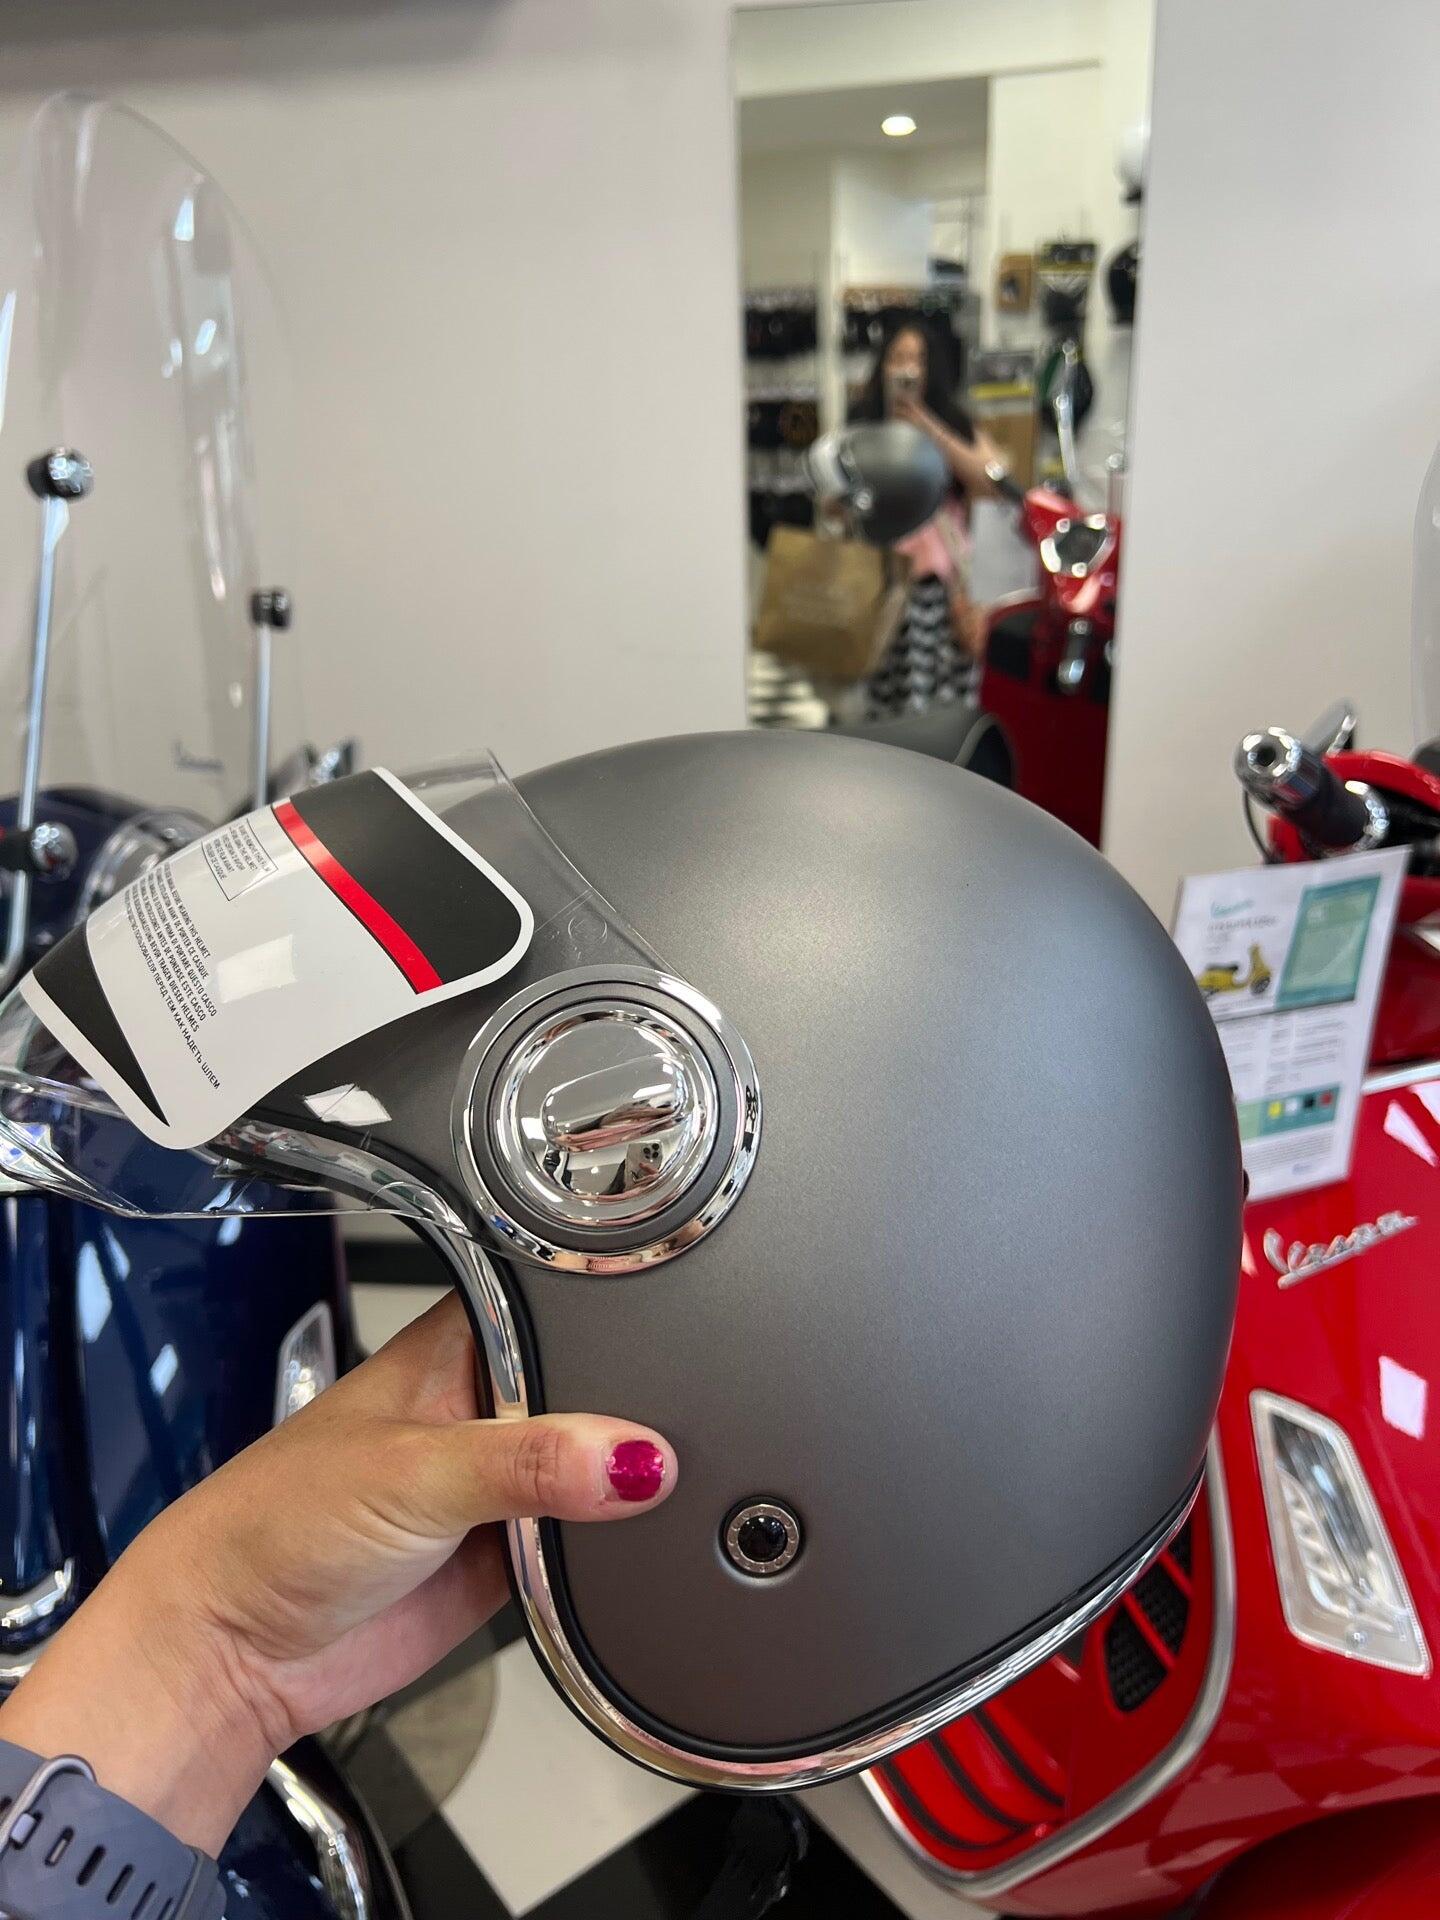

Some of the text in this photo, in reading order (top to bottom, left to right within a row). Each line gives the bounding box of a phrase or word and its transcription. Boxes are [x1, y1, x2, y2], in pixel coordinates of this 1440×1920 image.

[163, 922, 175, 939] PRIMA
[173, 920, 182, 928] DE
[177, 903, 192, 925] WEARING
[187, 924, 198, 937] THIS
[194, 936, 210, 959] HELMET
[156, 930, 167, 947] ANTES
[170, 937, 178, 945] DI
[177, 926, 192, 948] PORTER
[163, 946, 172, 955] DE
[173, 944, 191, 970] PORTARE
[187, 946, 196, 955] CE
[167, 954, 185, 982] PONERSE
[191, 954, 209, 979] CASQUE
[149, 940, 162, 959] BEVOR
[157, 958, 173, 981] TRAGEN
[168, 980, 184, 1004] DIESER
[179, 1002, 200, 1033] HELMES
[180, 980, 194, 998] ESTE
[186, 968, 205, 994] QUESTO
[189, 997, 206, 1021] CASCO
[199, 992, 218, 1017] CASCO
[153, 972, 169, 997] ПЕРЕД
[164, 996, 176, 1013] ТЕМ
[172, 1011, 186, 1029] КАК
[180, 1027, 204, 1063] НАДЕТЬ
[199, 1061, 221, 1090] ШЛЕМ
[1263, 1210, 1419, 1289] Vespa
